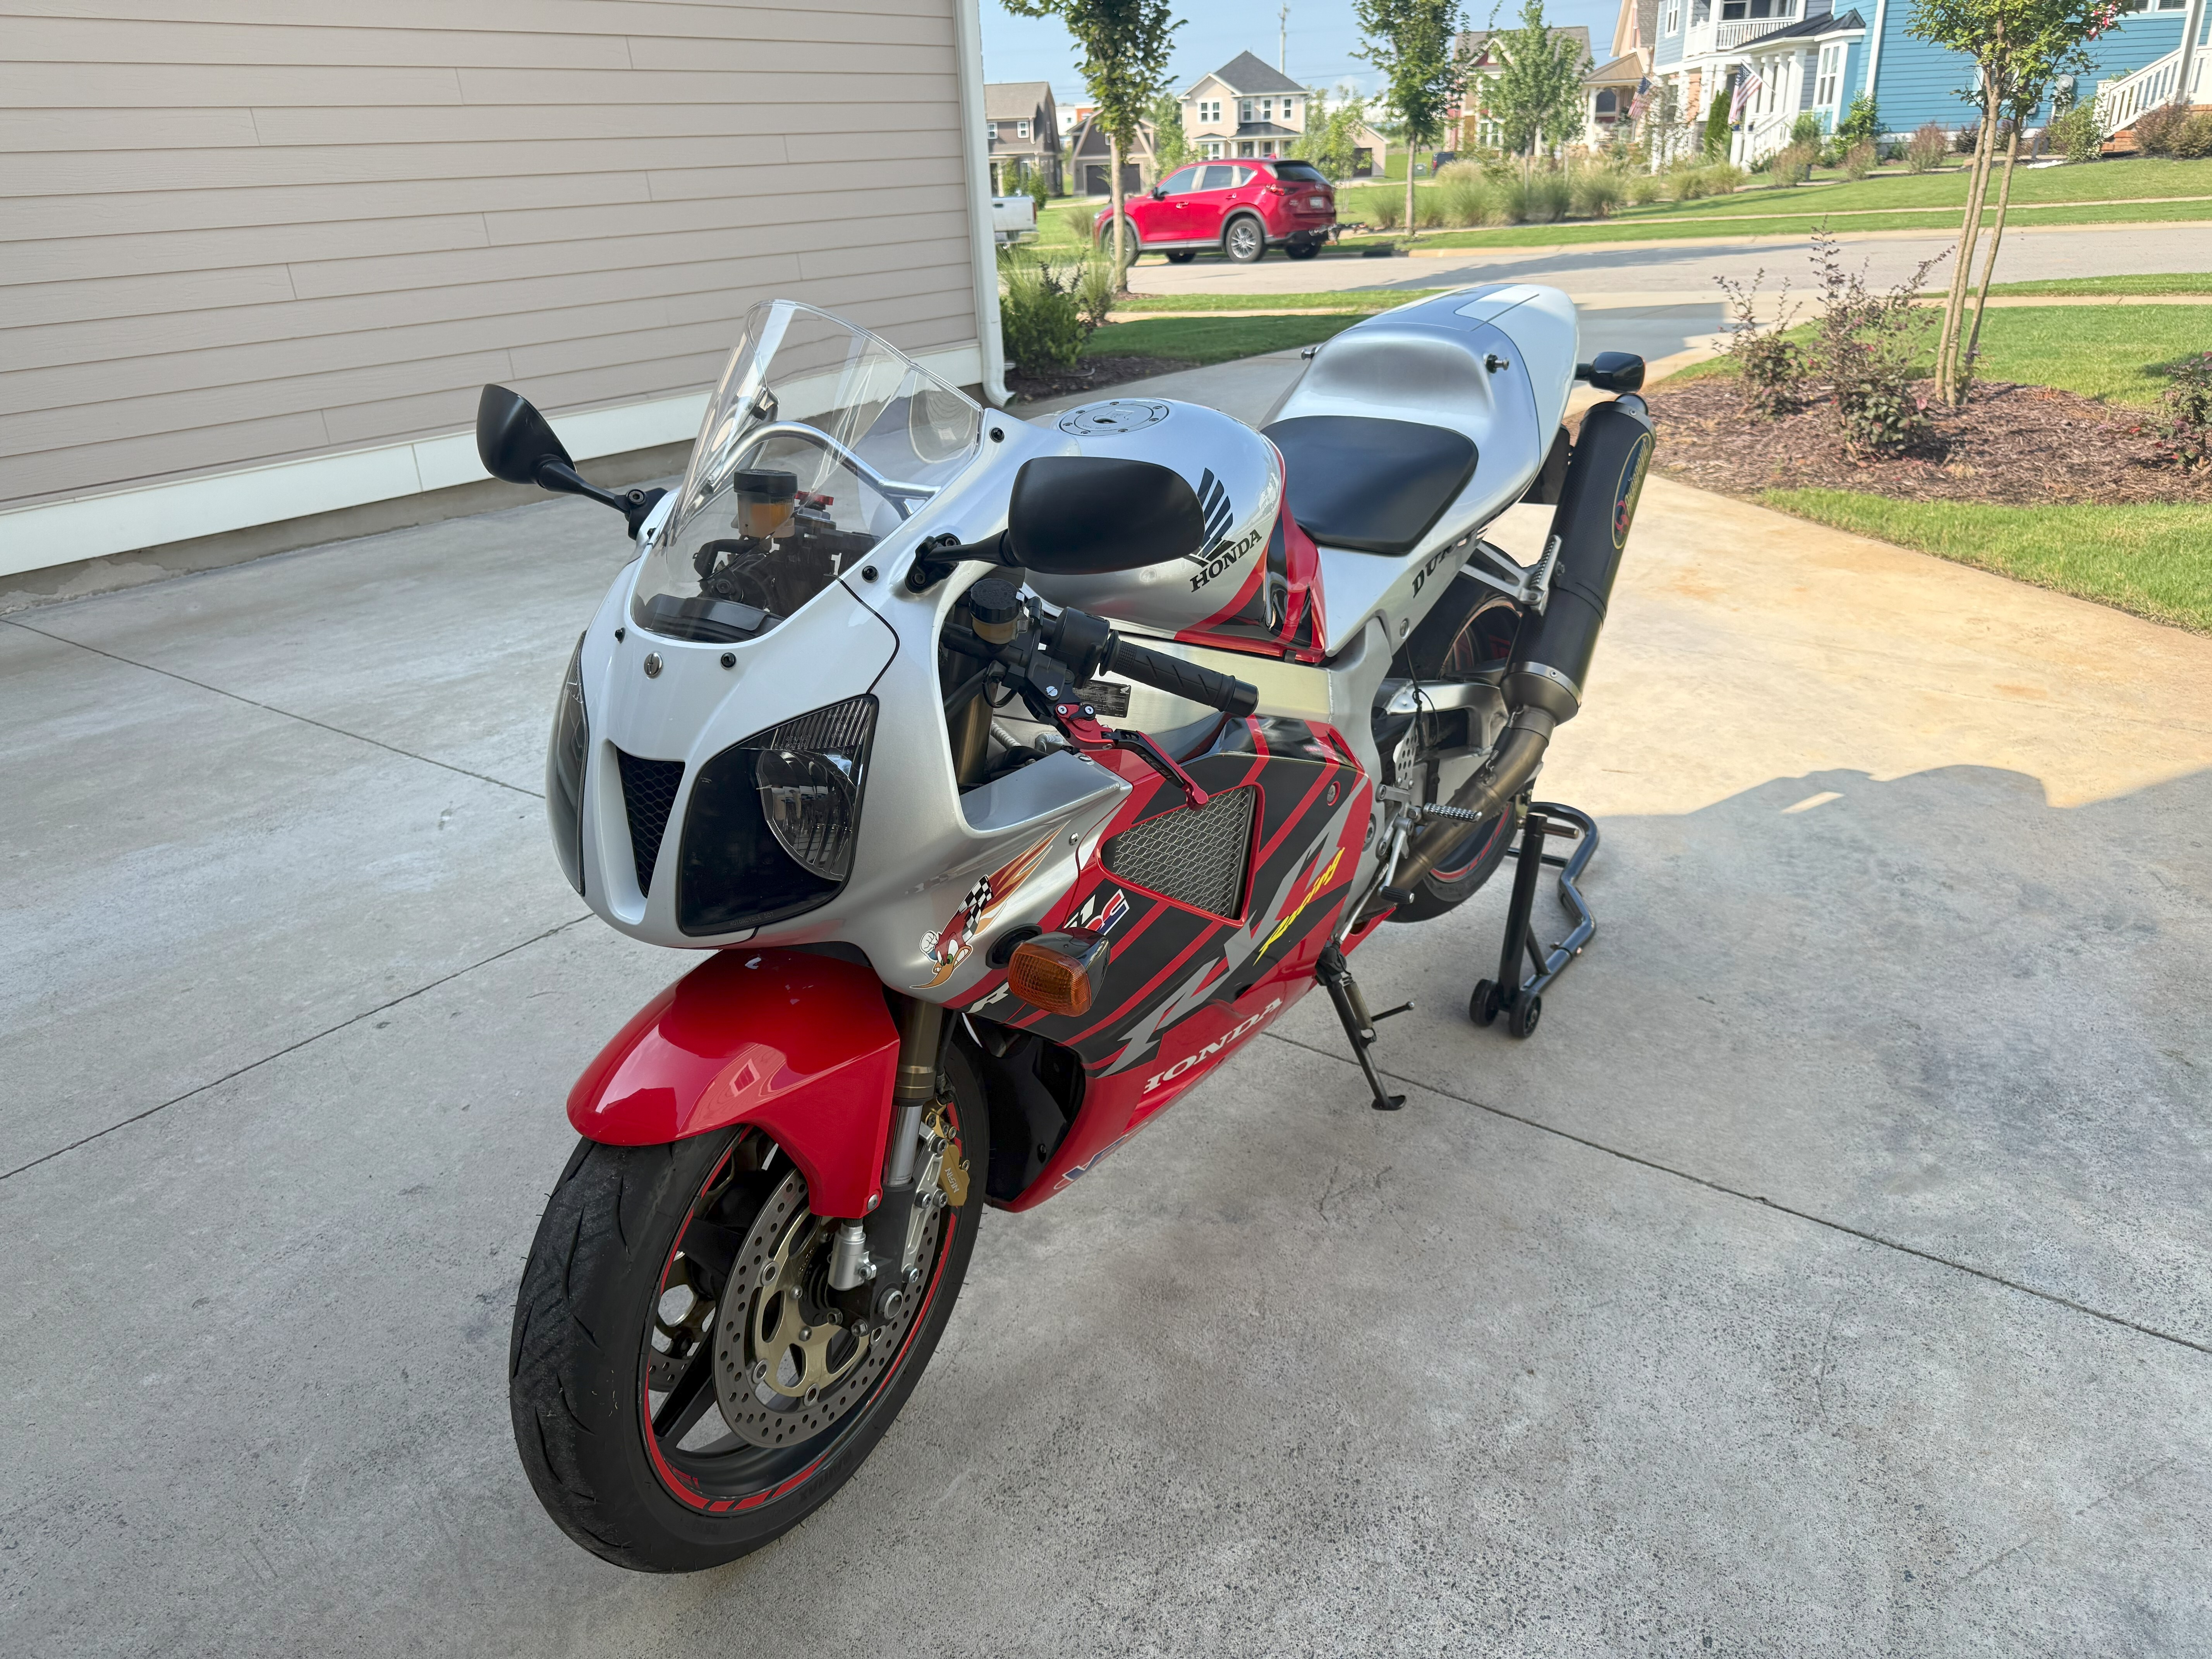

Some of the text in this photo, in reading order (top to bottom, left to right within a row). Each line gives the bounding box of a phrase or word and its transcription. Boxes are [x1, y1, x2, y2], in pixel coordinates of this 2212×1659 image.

[1190, 529, 1262, 592] HONDA
[730, 915, 762, 926] MOTORCYCLE
[1253, 847, 1345, 967] Racing
[1144, 998, 1283, 1095] HONDA
